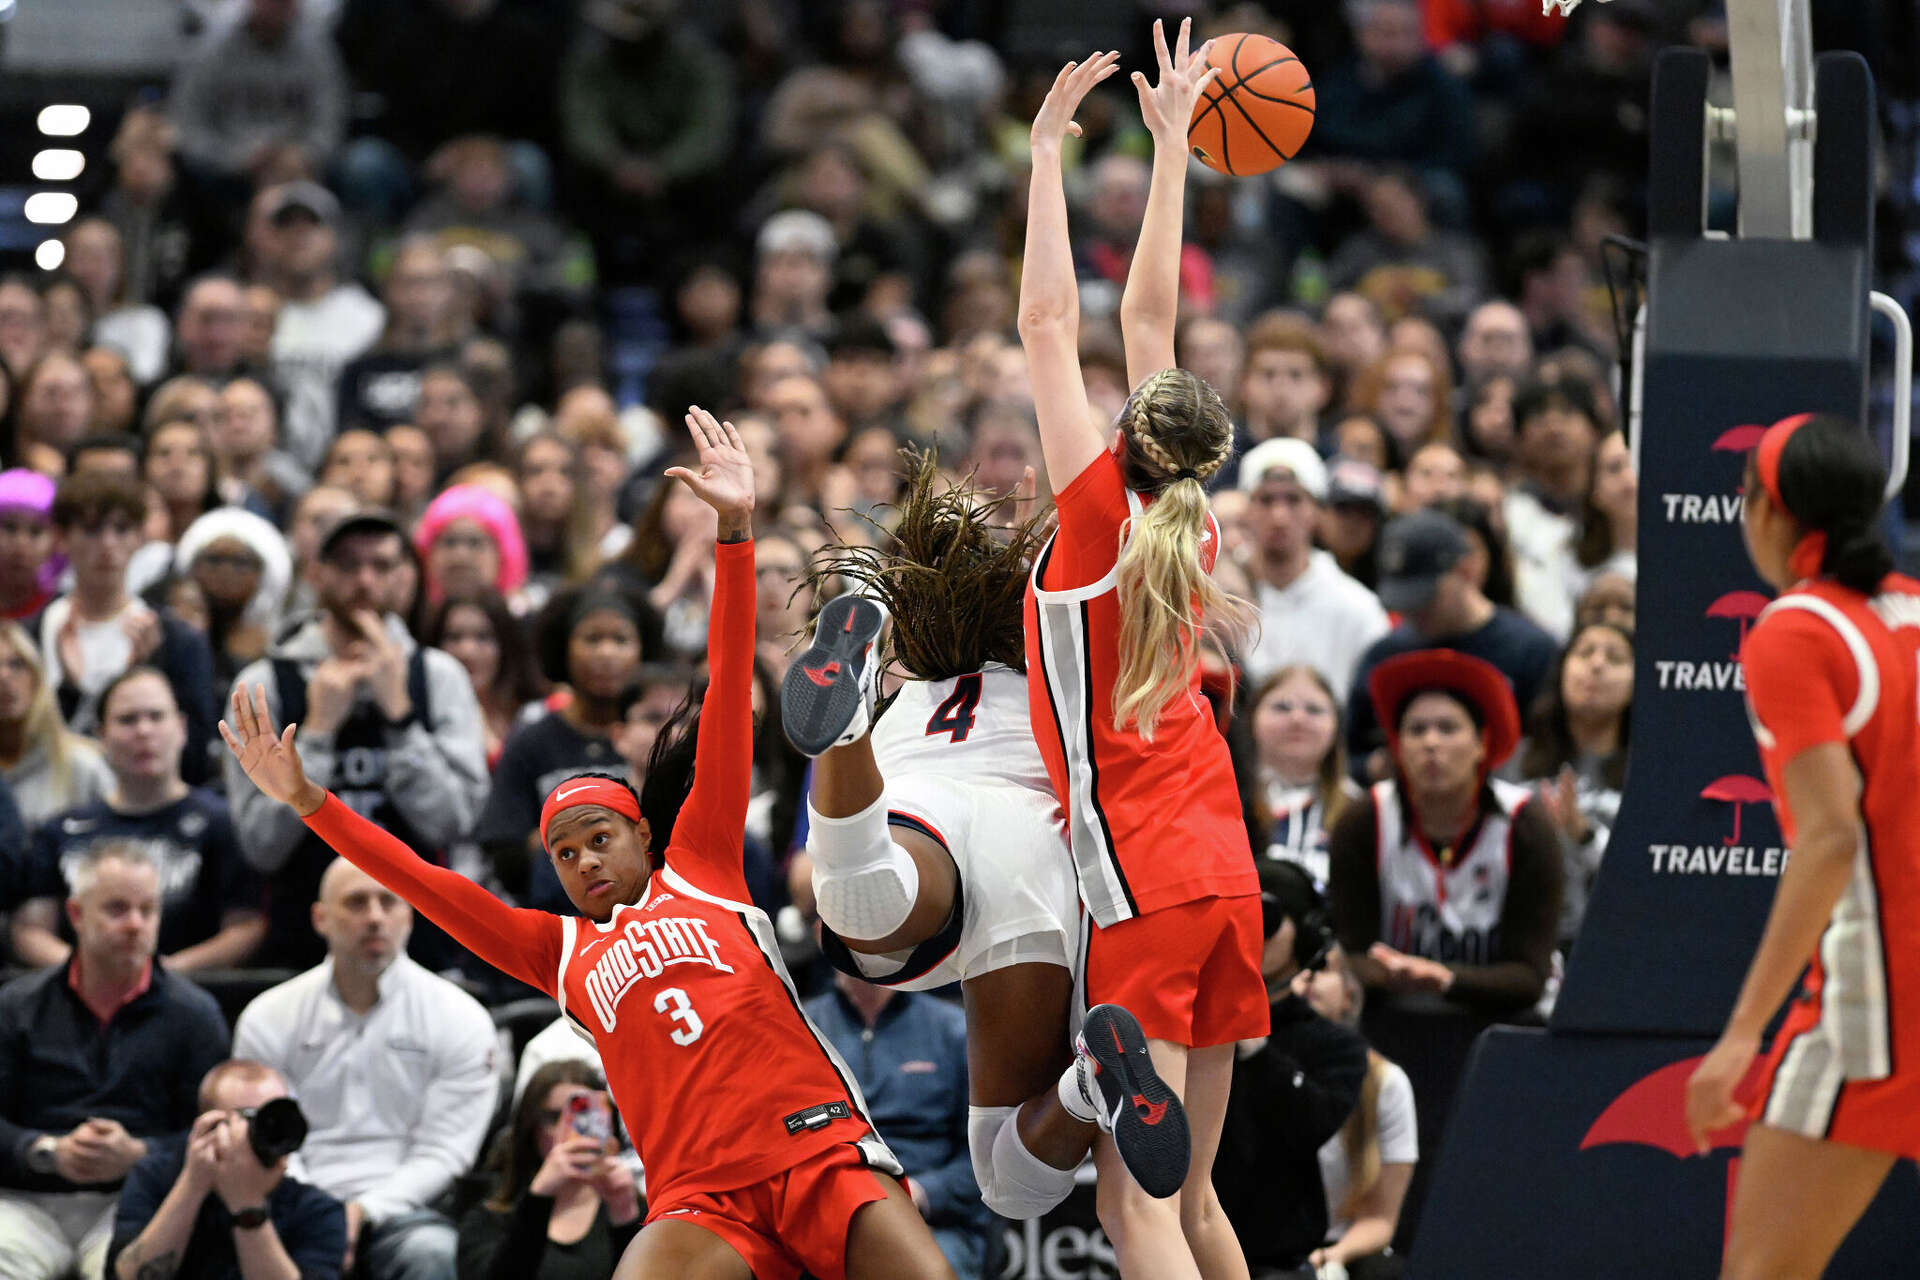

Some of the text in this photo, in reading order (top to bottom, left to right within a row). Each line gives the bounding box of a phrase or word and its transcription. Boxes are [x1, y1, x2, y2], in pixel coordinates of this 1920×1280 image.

[925, 672, 983, 743] 4
[654, 987, 704, 1047] 3
[830, 1106, 842, 1114] 42
